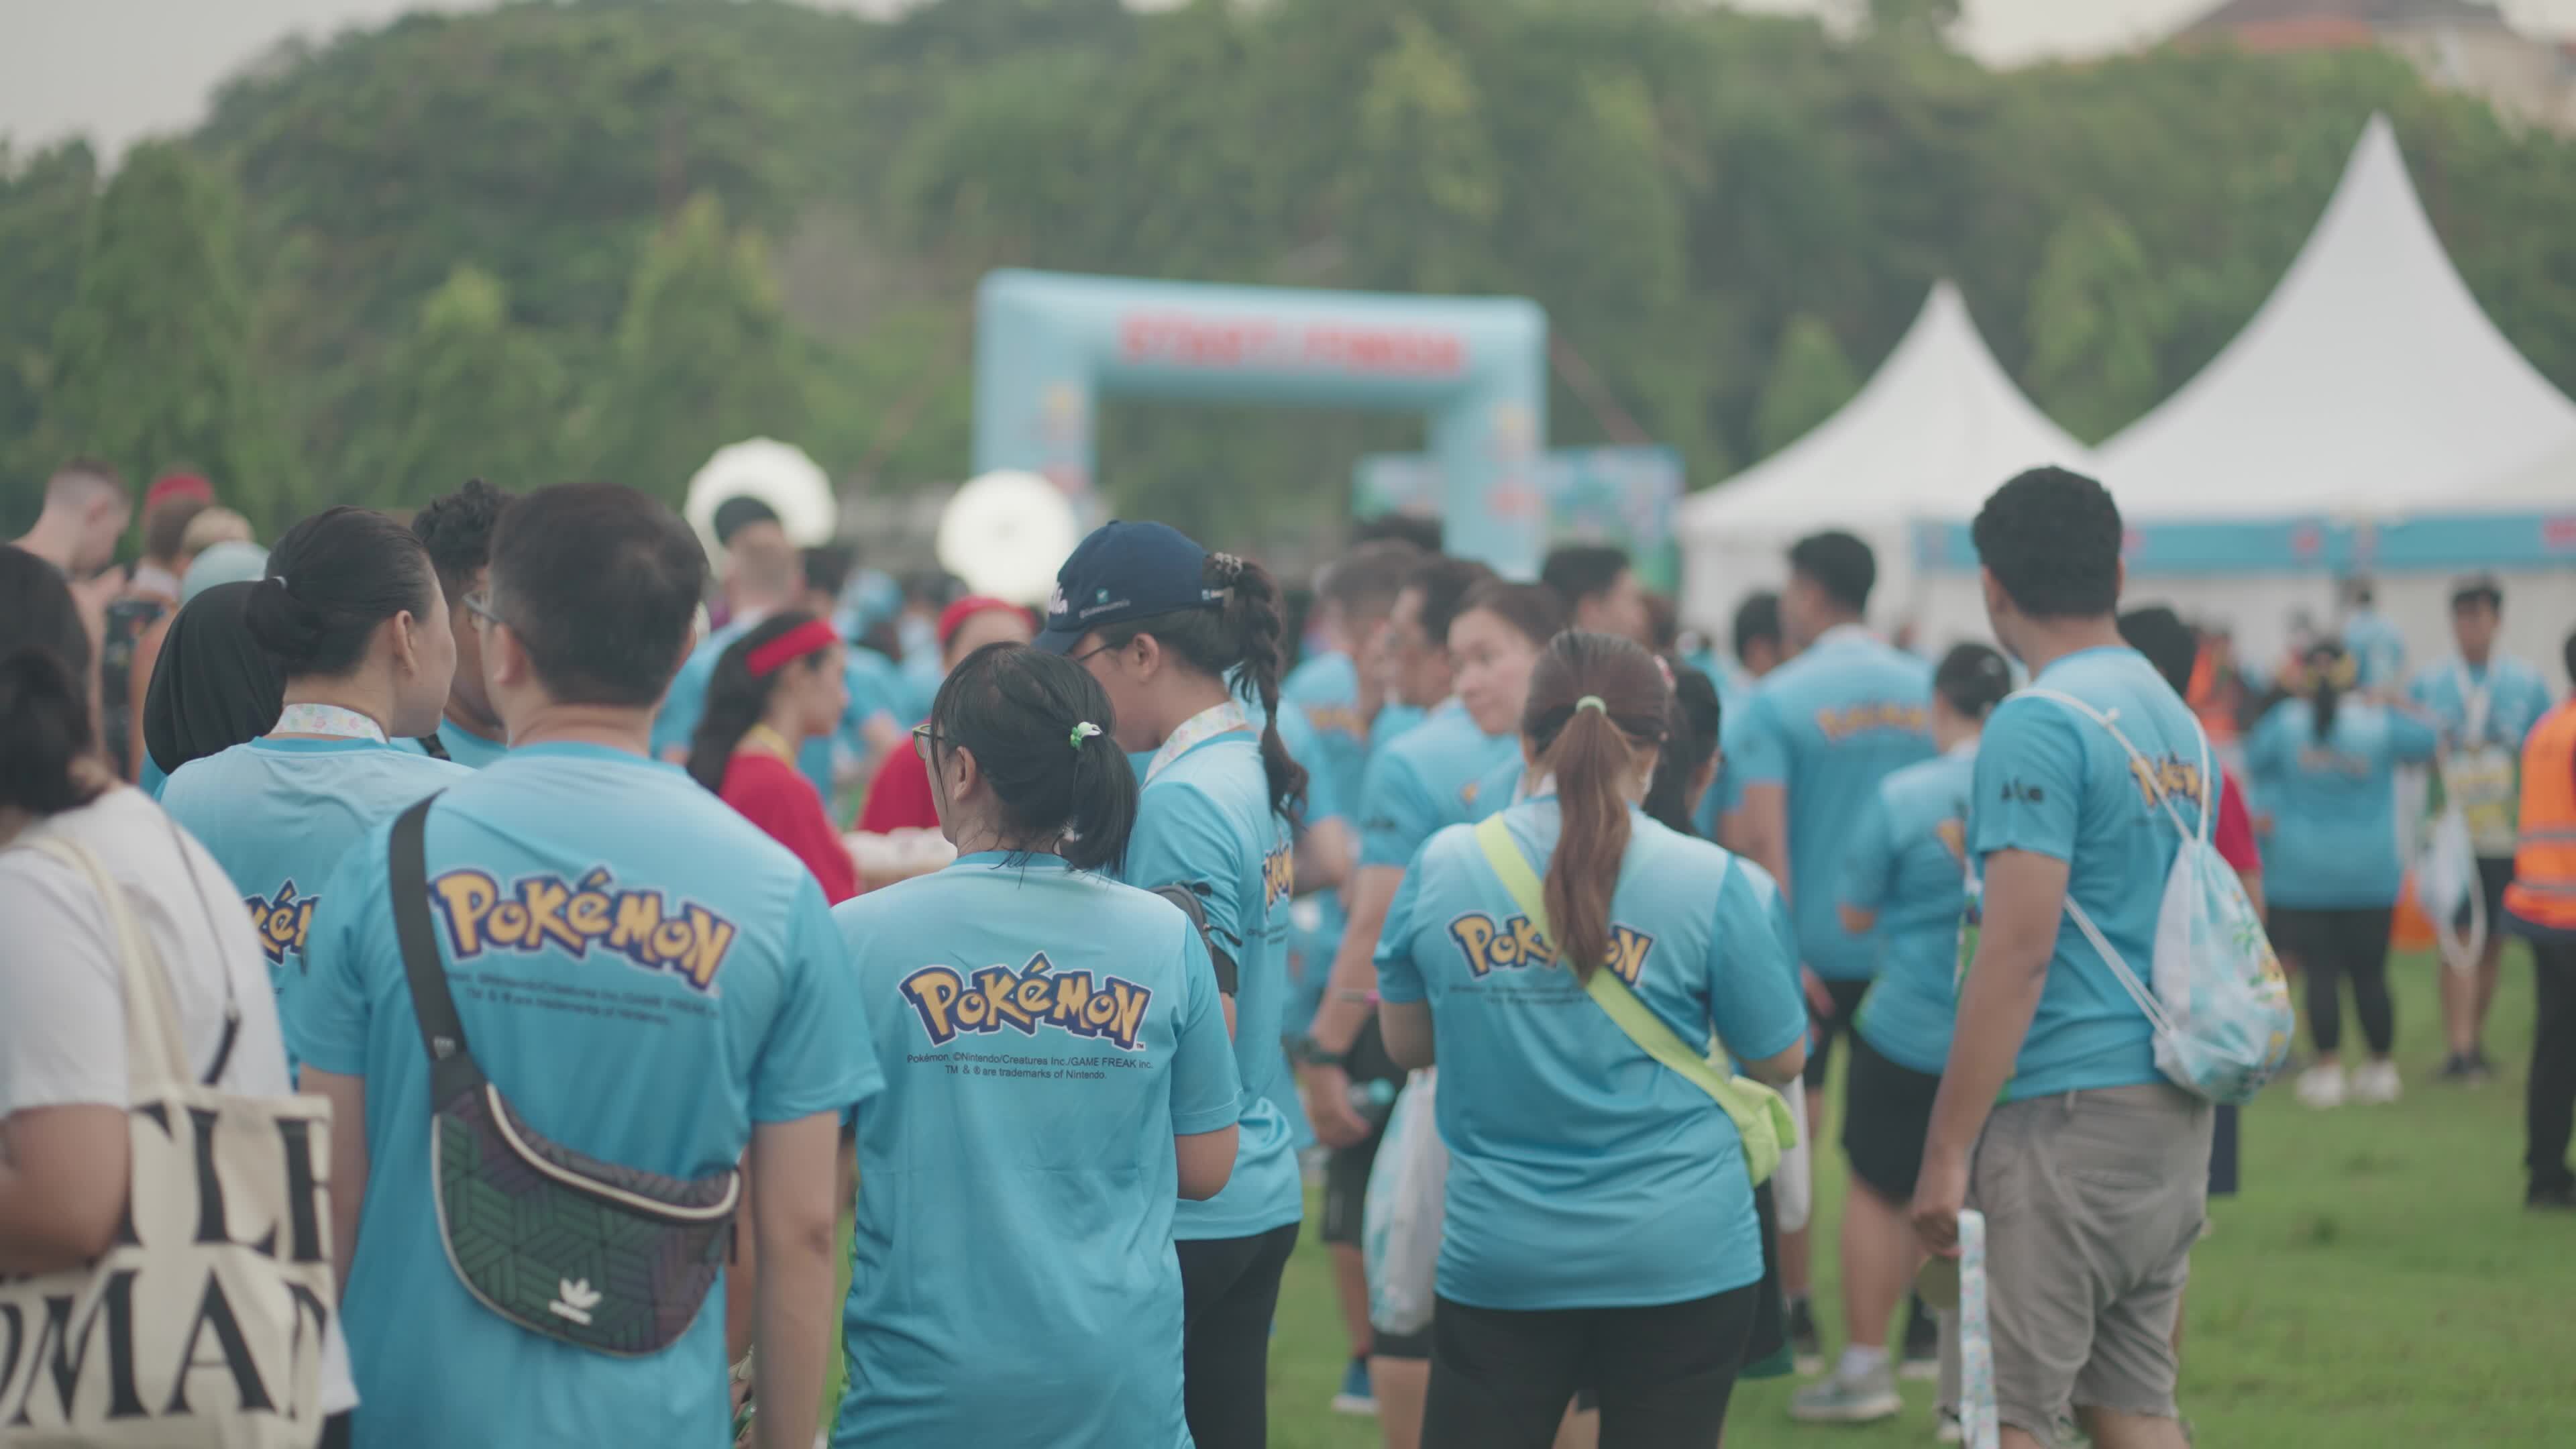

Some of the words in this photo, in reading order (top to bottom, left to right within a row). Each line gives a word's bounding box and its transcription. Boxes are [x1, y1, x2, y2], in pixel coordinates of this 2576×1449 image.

[427, 867, 735, 991] Pokémon
[898, 949, 1152, 1051] Pokémon
[945, 1065, 959, 1074] TM
[962, 1064, 971, 1074] &
[982, 1067, 997, 1076] are
[999, 1067, 1052, 1079] trademarks
[1053, 1069, 1064, 1079] of
[1102, 1057, 1137, 1069] FREAK
